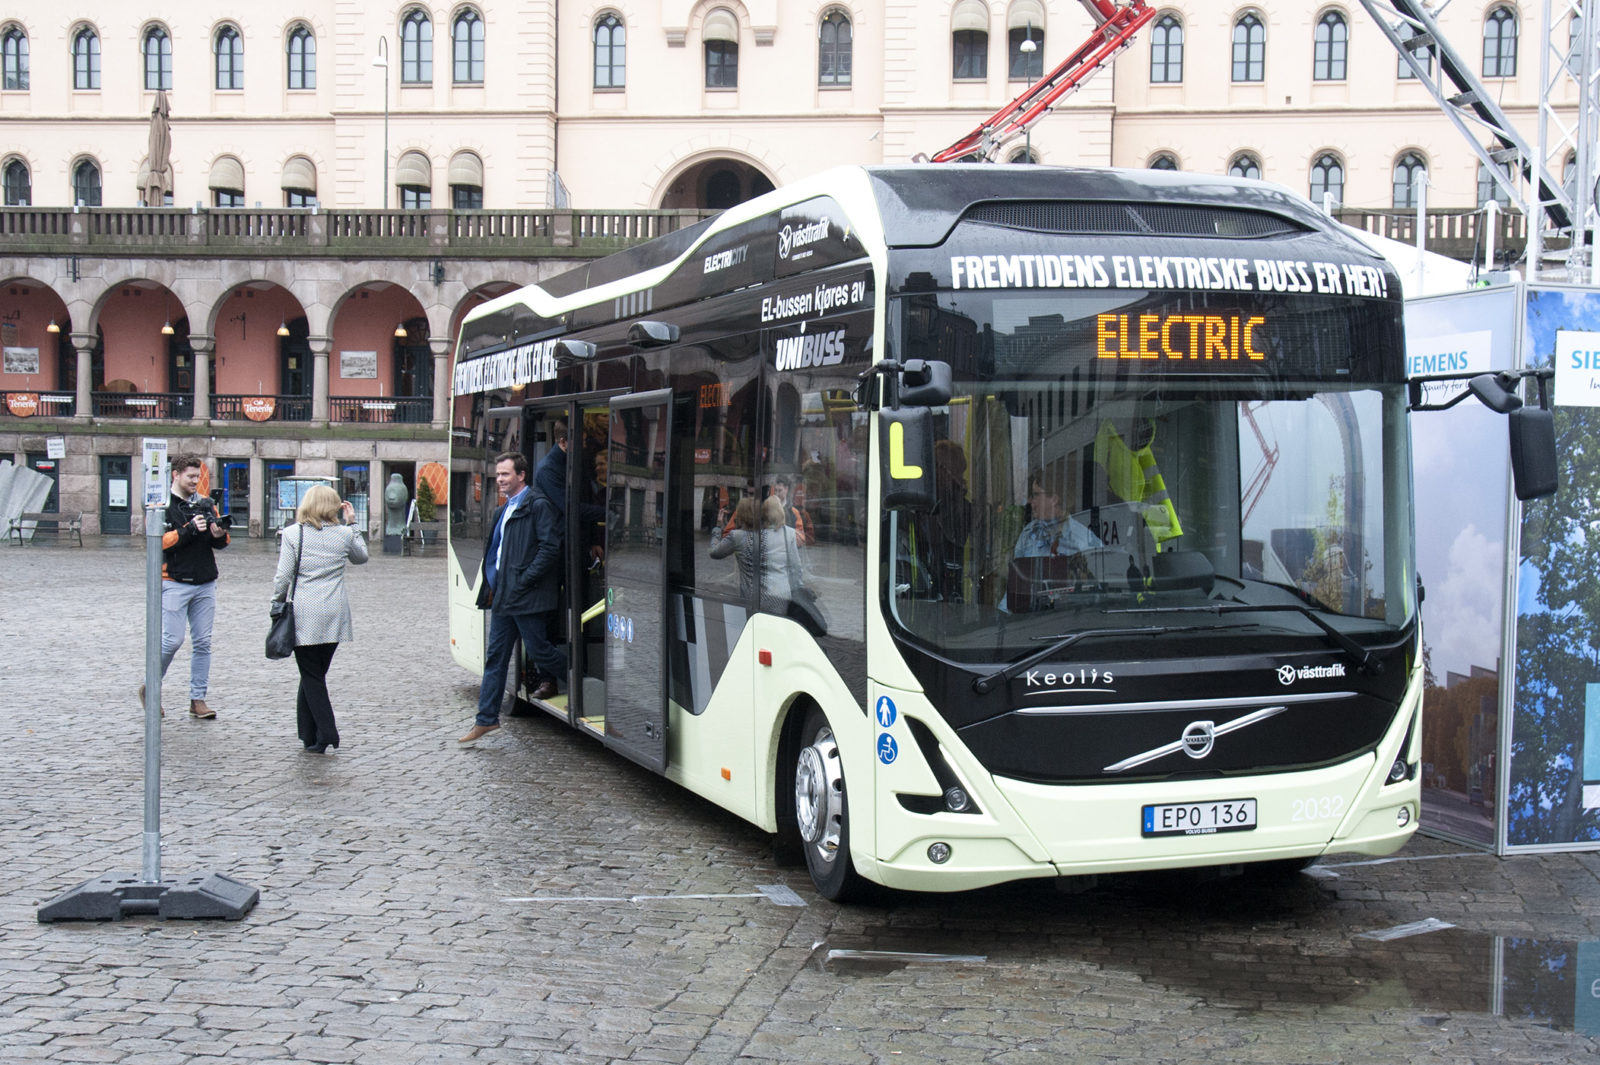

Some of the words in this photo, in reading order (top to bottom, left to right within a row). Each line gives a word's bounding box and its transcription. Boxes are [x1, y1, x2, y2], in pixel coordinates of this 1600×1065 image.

[792, 216, 830, 248] västtrafik
[703, 244, 749, 274] ELECTRICITY
[951, 255, 1110, 289] FREMTIDENS
[1112, 255, 1253, 290] ELEKTRISKE
[1254, 259, 1312, 293] BUSS
[1312, 262, 1342, 295] ER
[1342, 263, 1388, 298] HER!
[761, 292, 812, 322] EL-bussen
[814, 284, 849, 316] kjøres
[851, 281, 865, 303] av
[1097, 314, 1265, 360] ELECTRIC
[1408, 351, 1468, 374] IEMENS
[890, 422, 922, 479] L
[1026, 668, 1114, 686] Keolis
[1297, 664, 1346, 679] västtrafik
[1211, 803, 1248, 825] 136
[1292, 794, 1345, 821] 2032
